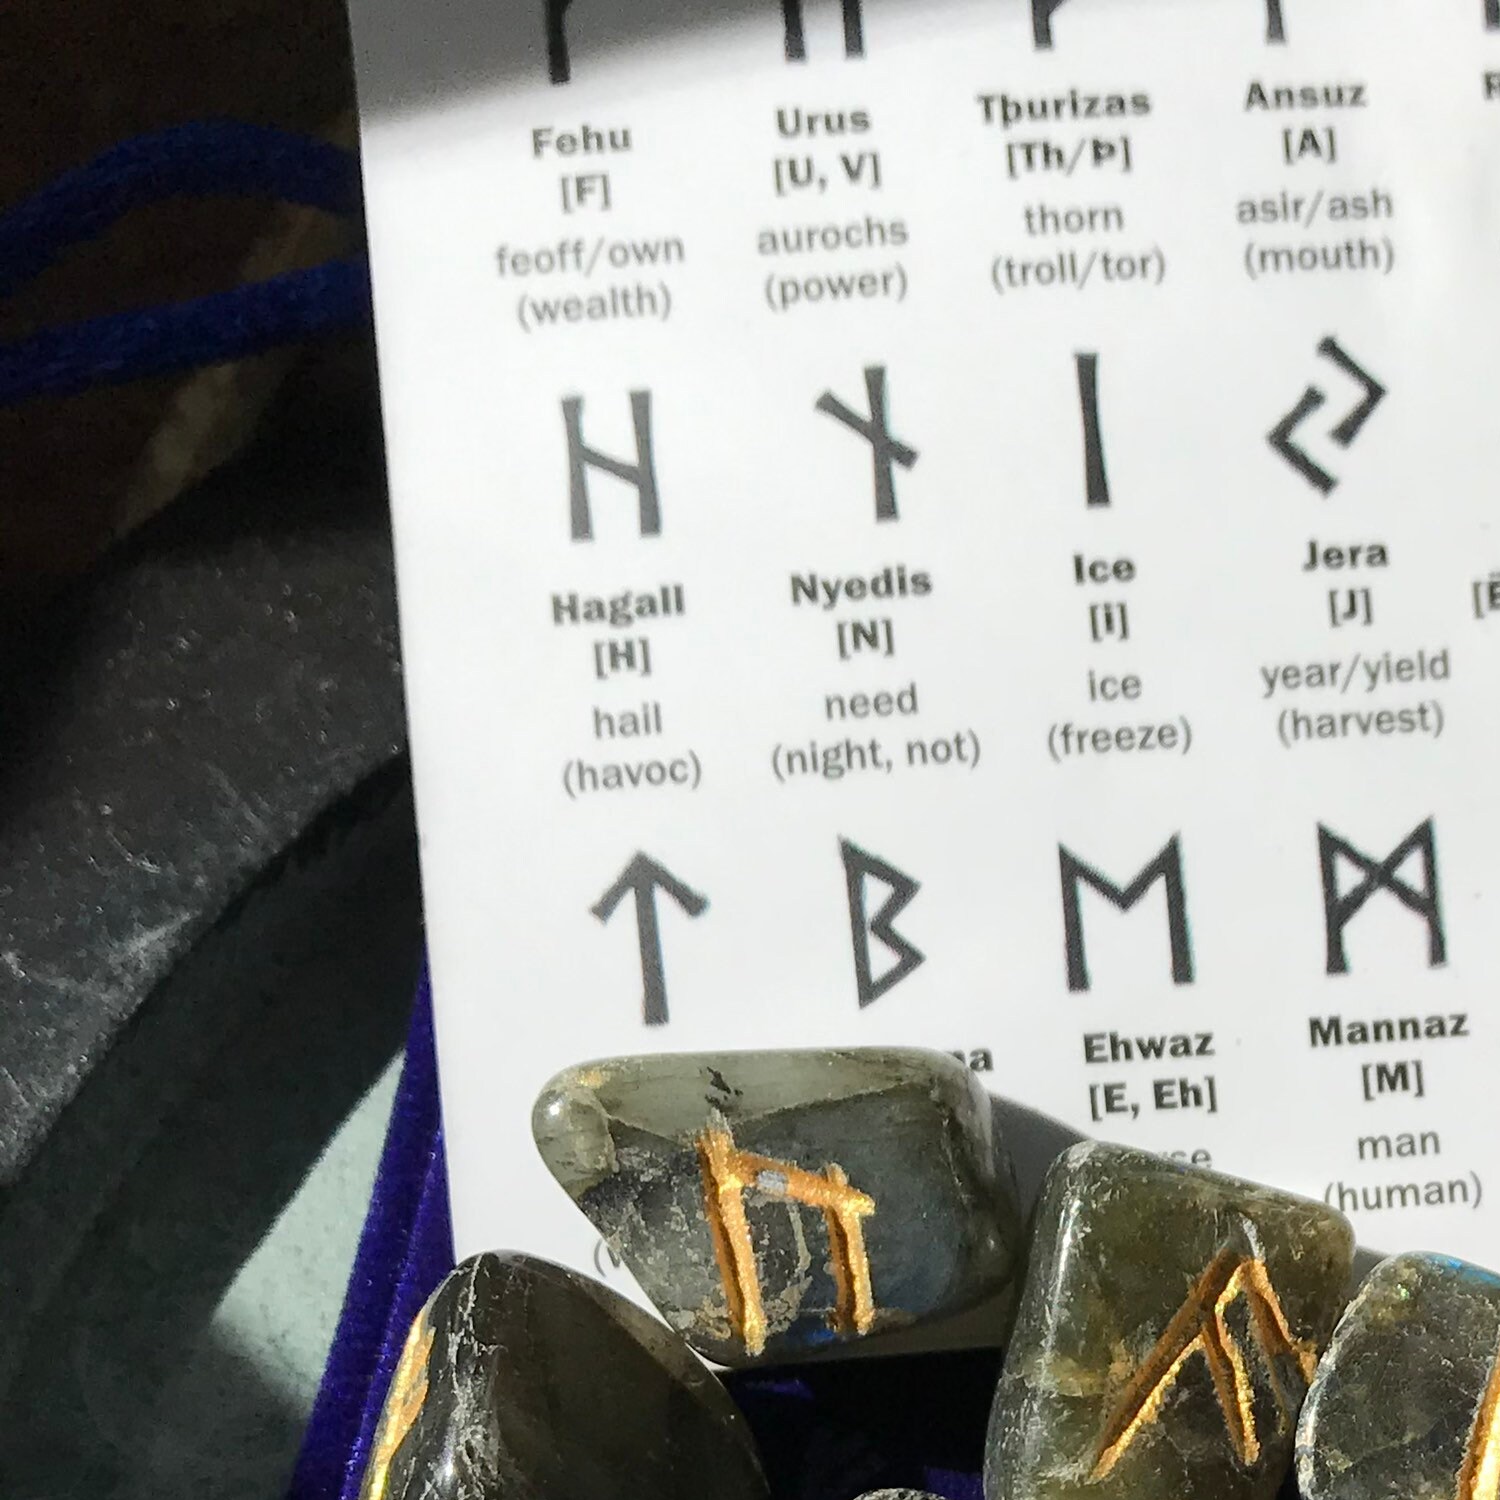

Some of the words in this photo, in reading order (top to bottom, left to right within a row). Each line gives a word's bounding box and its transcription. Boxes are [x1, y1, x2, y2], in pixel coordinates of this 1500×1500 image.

[1245, 81, 1365, 111] Ansuz
[531, 124, 632, 158] Fehu
[776, 107, 871, 139] Urus
[1282, 127, 1337, 165] [A]
[560, 173, 612, 214] [F]
[773, 156, 827, 196] [U,
[839, 151, 881, 188] V]
[1023, 203, 1125, 236] thorn
[1236, 187, 1394, 227] asir/ash
[757, 215, 910, 256] aurochs
[494, 237, 686, 277] feoff/own
[991, 248, 1166, 294] (troll/tor)
[1244, 237, 1395, 279] (mouth)
[516, 281, 672, 332] (wealth)
[764, 263, 908, 311] (power)
[1073, 554, 1136, 585] Ice
[1303, 540, 1389, 571] Jera
[551, 584, 686, 628] Hagall
[790, 565, 933, 610] Nyedis
[1328, 587, 1373, 628] [J]
[836, 618, 895, 660] [N]
[1089, 602, 1129, 642] [I]
[593, 638, 652, 680] [H]
[1260, 648, 1451, 699] year/yield
[824, 681, 919, 721] need
[1088, 669, 1142, 702] ice
[592, 701, 663, 740] hail
[1047, 716, 1193, 762] (freeze)
[1277, 699, 1446, 749] (harvest)
[562, 750, 702, 799] (havoc)
[771, 738, 893, 782] (night,
[906, 729, 981, 769] not)
[1083, 1031, 1214, 1064] Ehwaz
[1308, 1013, 1469, 1048] Mannaz
[1088, 1082, 1140, 1123] [E,
[1152, 1076, 1218, 1114] Eh]
[1361, 1060, 1425, 1102] [M]
[1357, 1131, 1441, 1161] man
[1323, 1170, 1483, 1212] (human)
